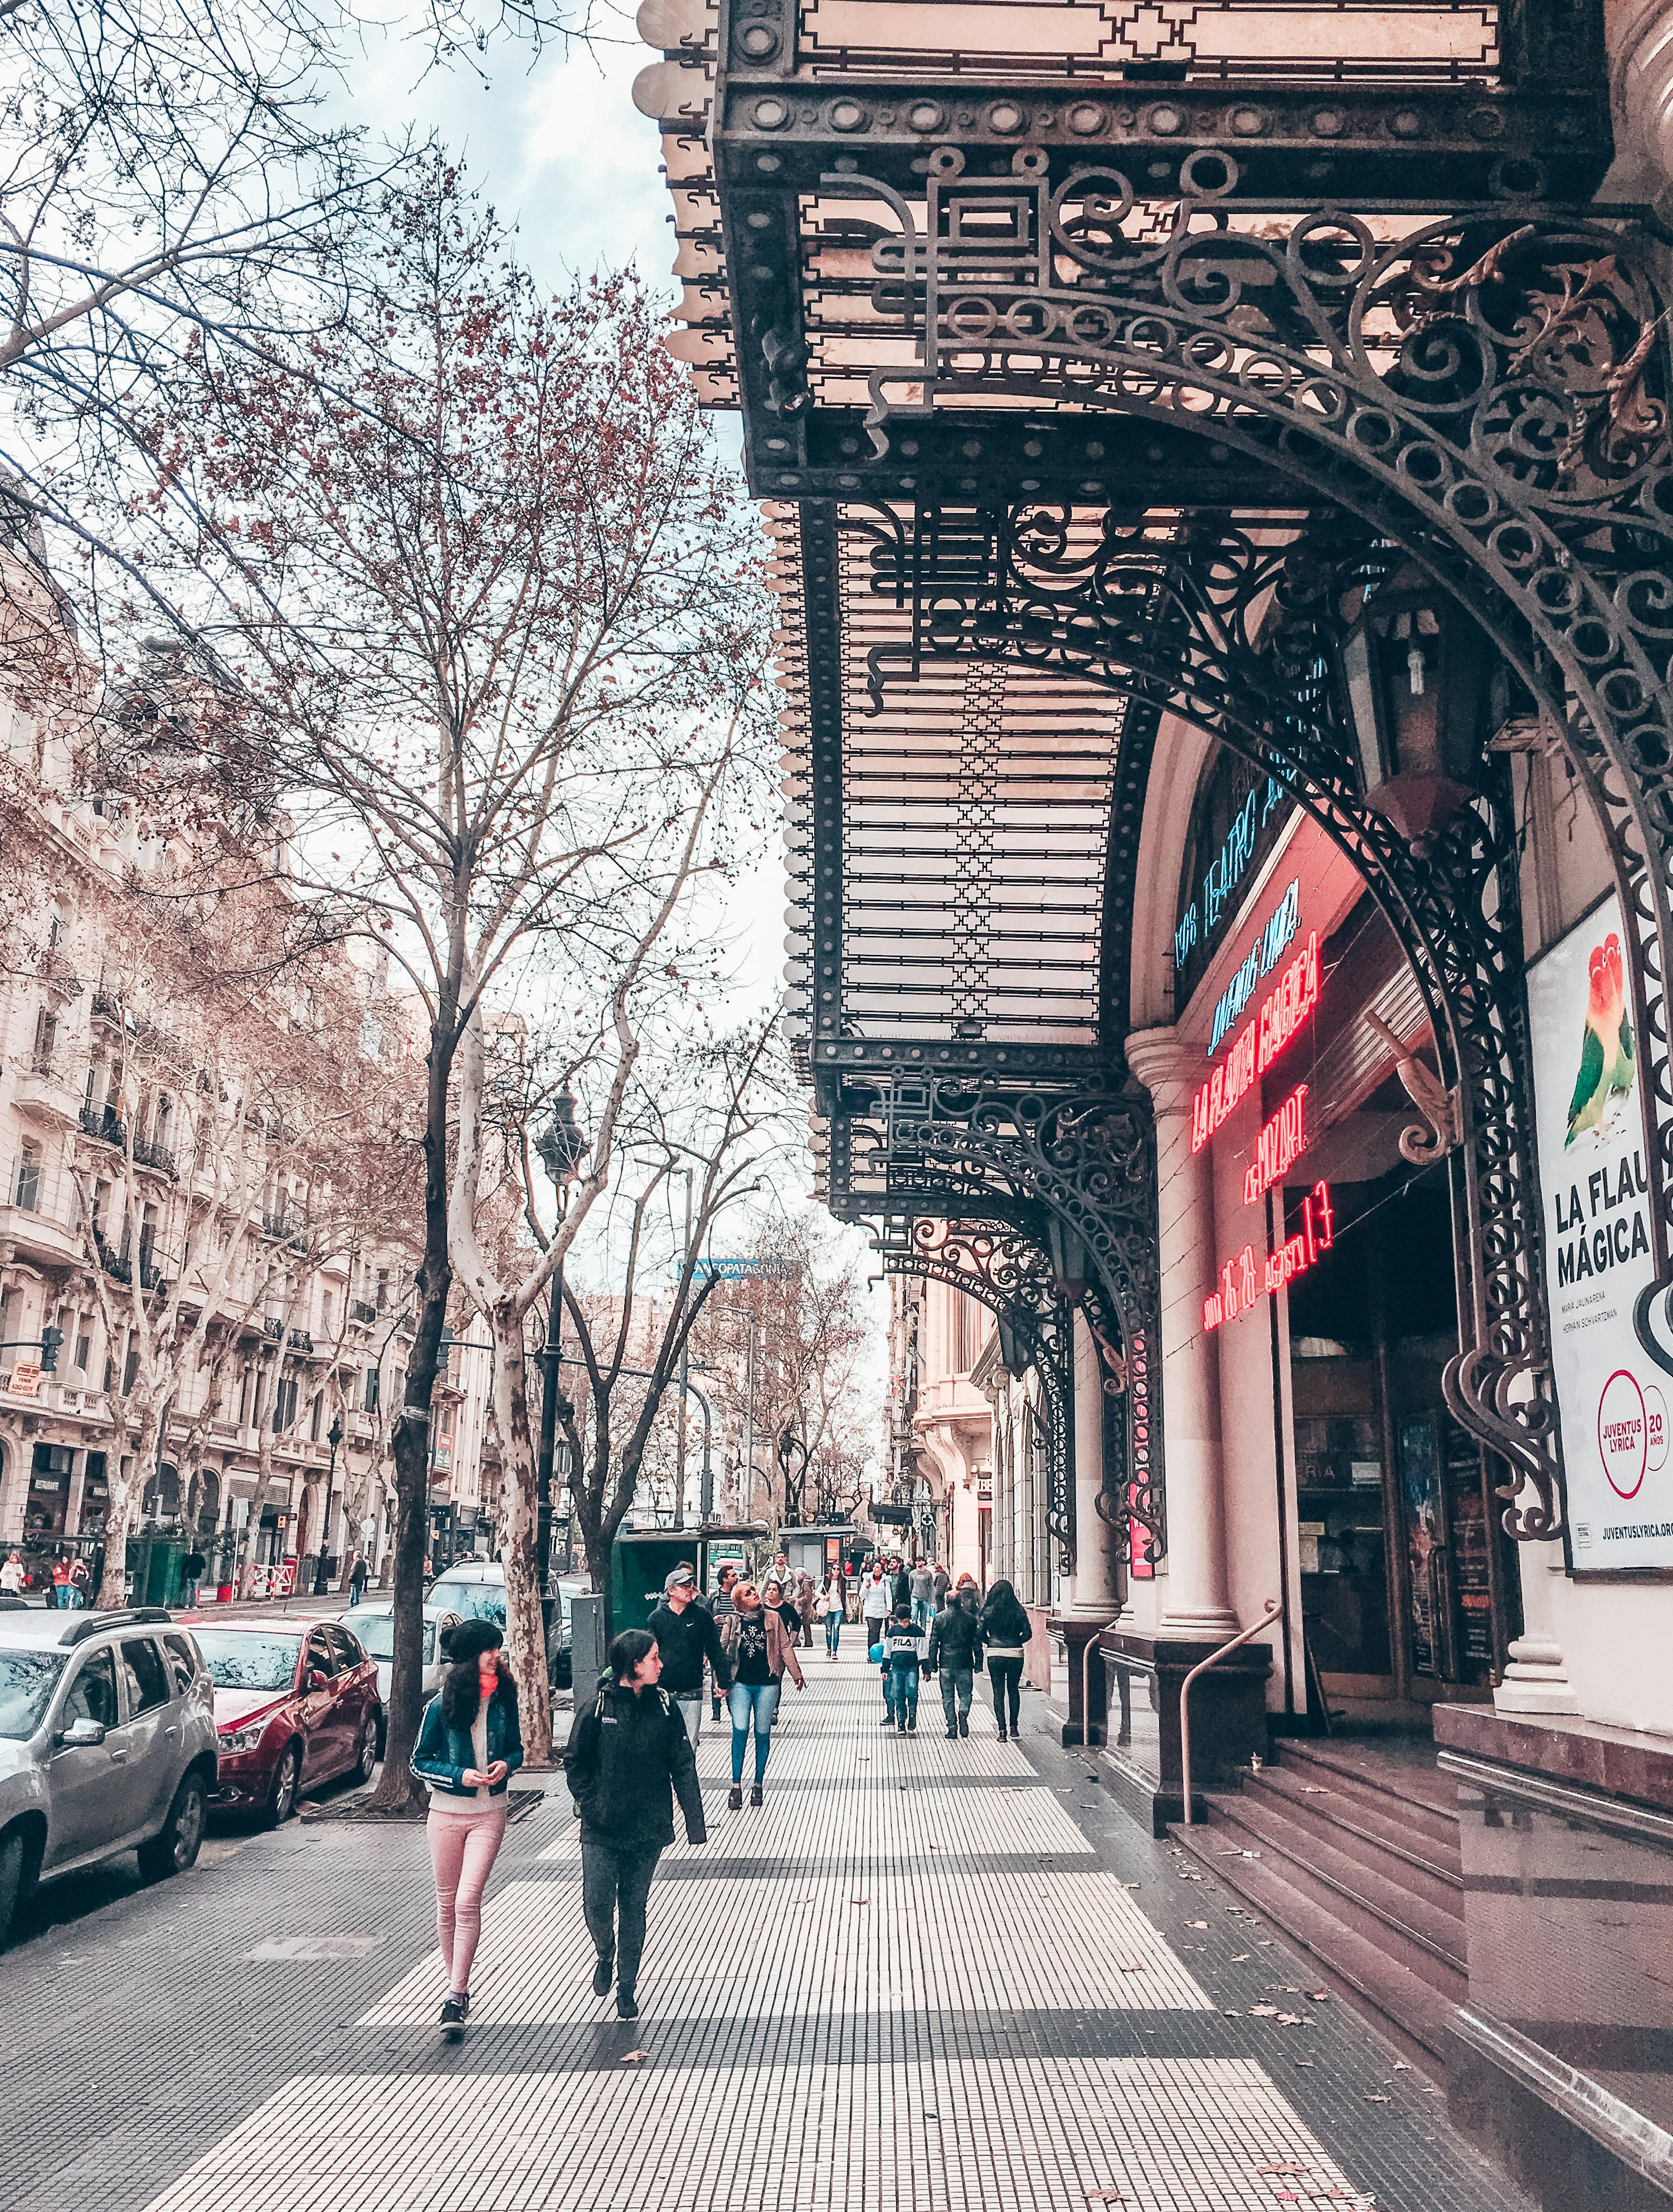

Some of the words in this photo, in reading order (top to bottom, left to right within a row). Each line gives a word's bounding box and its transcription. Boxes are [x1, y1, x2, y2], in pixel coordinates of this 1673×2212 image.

[1203, 789, 1256, 938] TEATRO
[1191, 1083, 1208, 1153] LA
[1256, 1083, 1309, 1195] MOZART
[1555, 1183, 1584, 1235] LA
[1558, 1211, 1650, 1288] MÁGICA
[1603, 1419, 1642, 1439] JUVENTUS
[1649, 1414, 1662, 1433] 20
[1650, 1435, 1664, 1446] AÑOS
[1609, 1435, 1636, 1453] LYRICA
[893, 1638, 912, 1647] FILA
